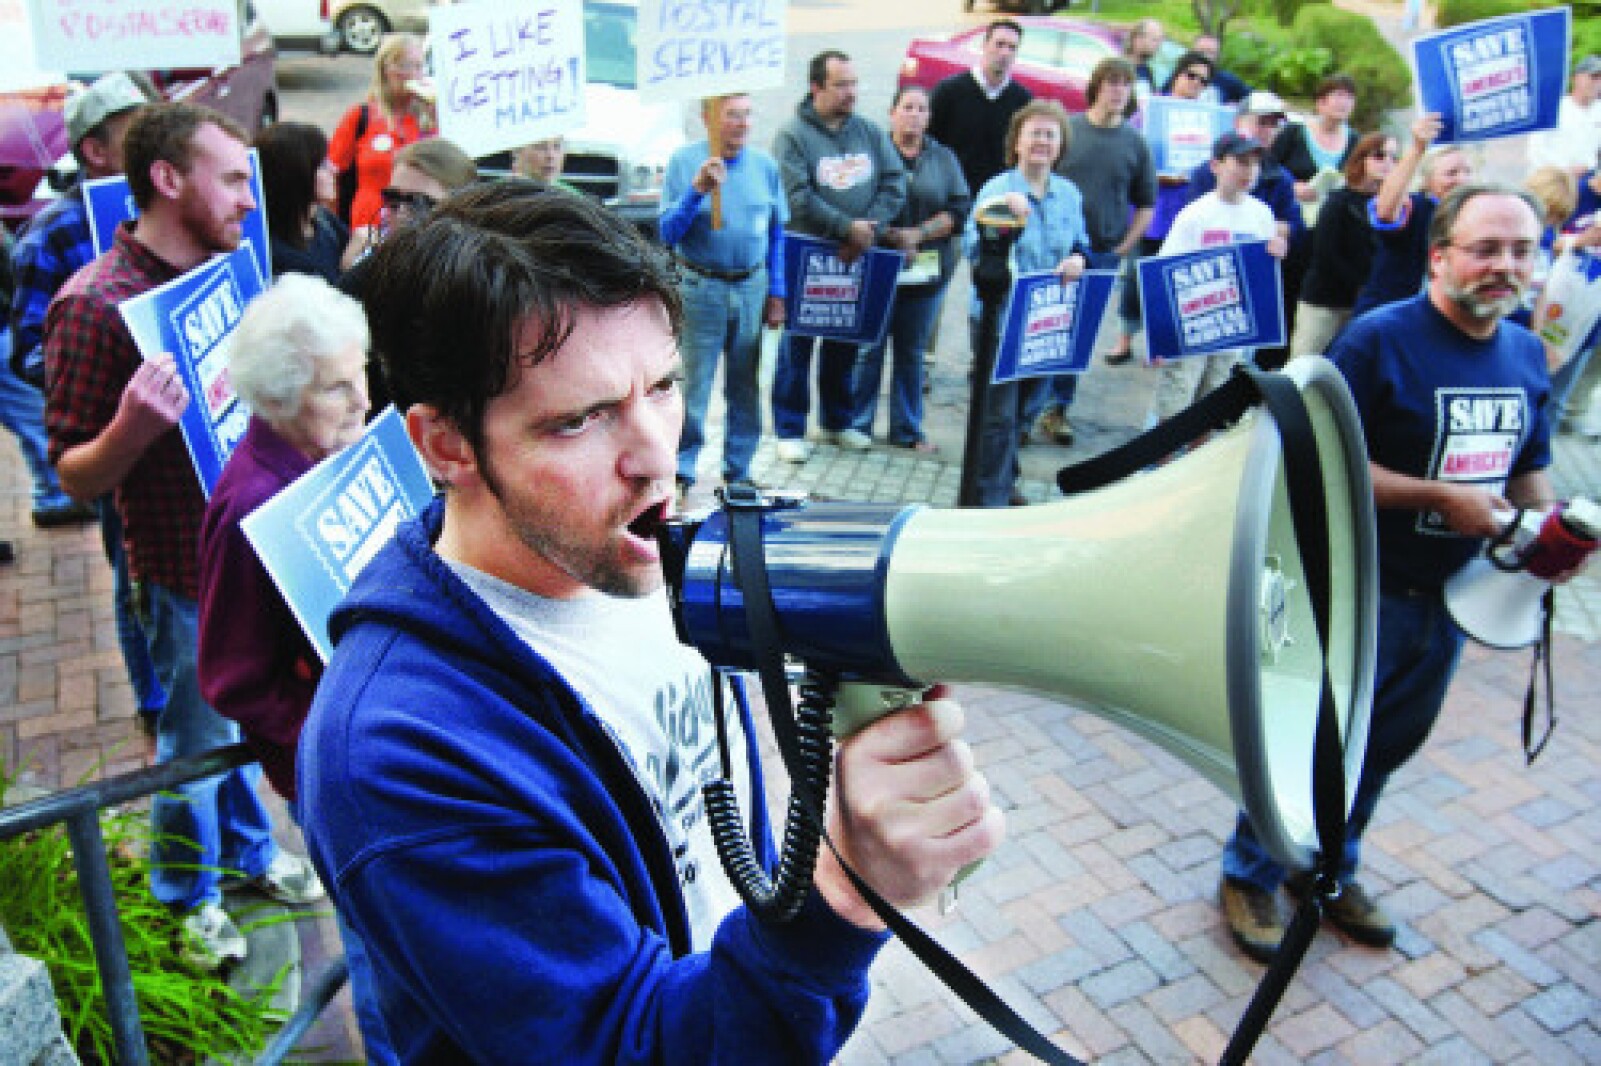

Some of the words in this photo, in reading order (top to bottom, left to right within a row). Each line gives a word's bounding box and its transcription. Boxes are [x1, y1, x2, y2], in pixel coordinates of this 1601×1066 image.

[448, 28, 478, 61] I
[488, 10, 557, 58] LIKE
[647, 34, 782, 83] SERVICE
[1453, 28, 1525, 67] SAVE
[1172, 253, 1237, 288] SAVE
[185, 279, 241, 360] SAVE
[1450, 397, 1522, 430] SAVE
[317, 456, 397, 562] SAVE
